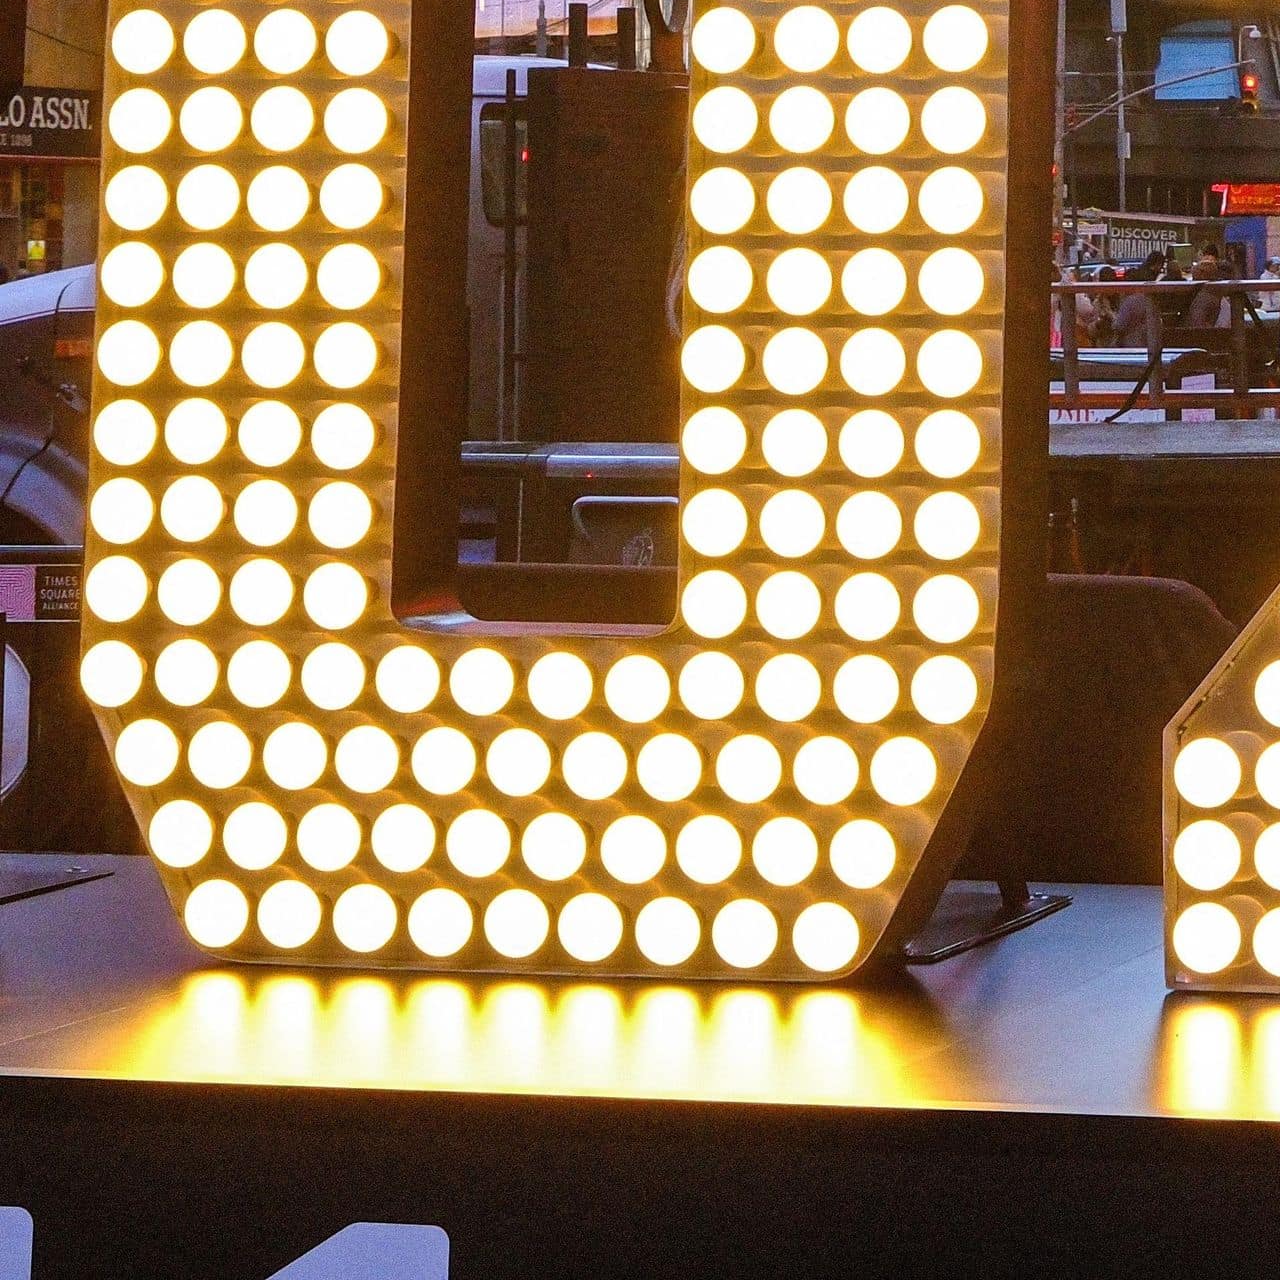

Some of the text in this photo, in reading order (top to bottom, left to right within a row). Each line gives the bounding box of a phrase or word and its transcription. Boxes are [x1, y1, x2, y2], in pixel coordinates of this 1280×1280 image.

[29, 96, 93, 130] ASSN.
[1110, 226, 1178, 241] DISCOVER
[44, 575, 78, 586] TIMES
[40, 588, 81, 601] SQUARE
[42, 602, 79, 610] ALLIANCE
